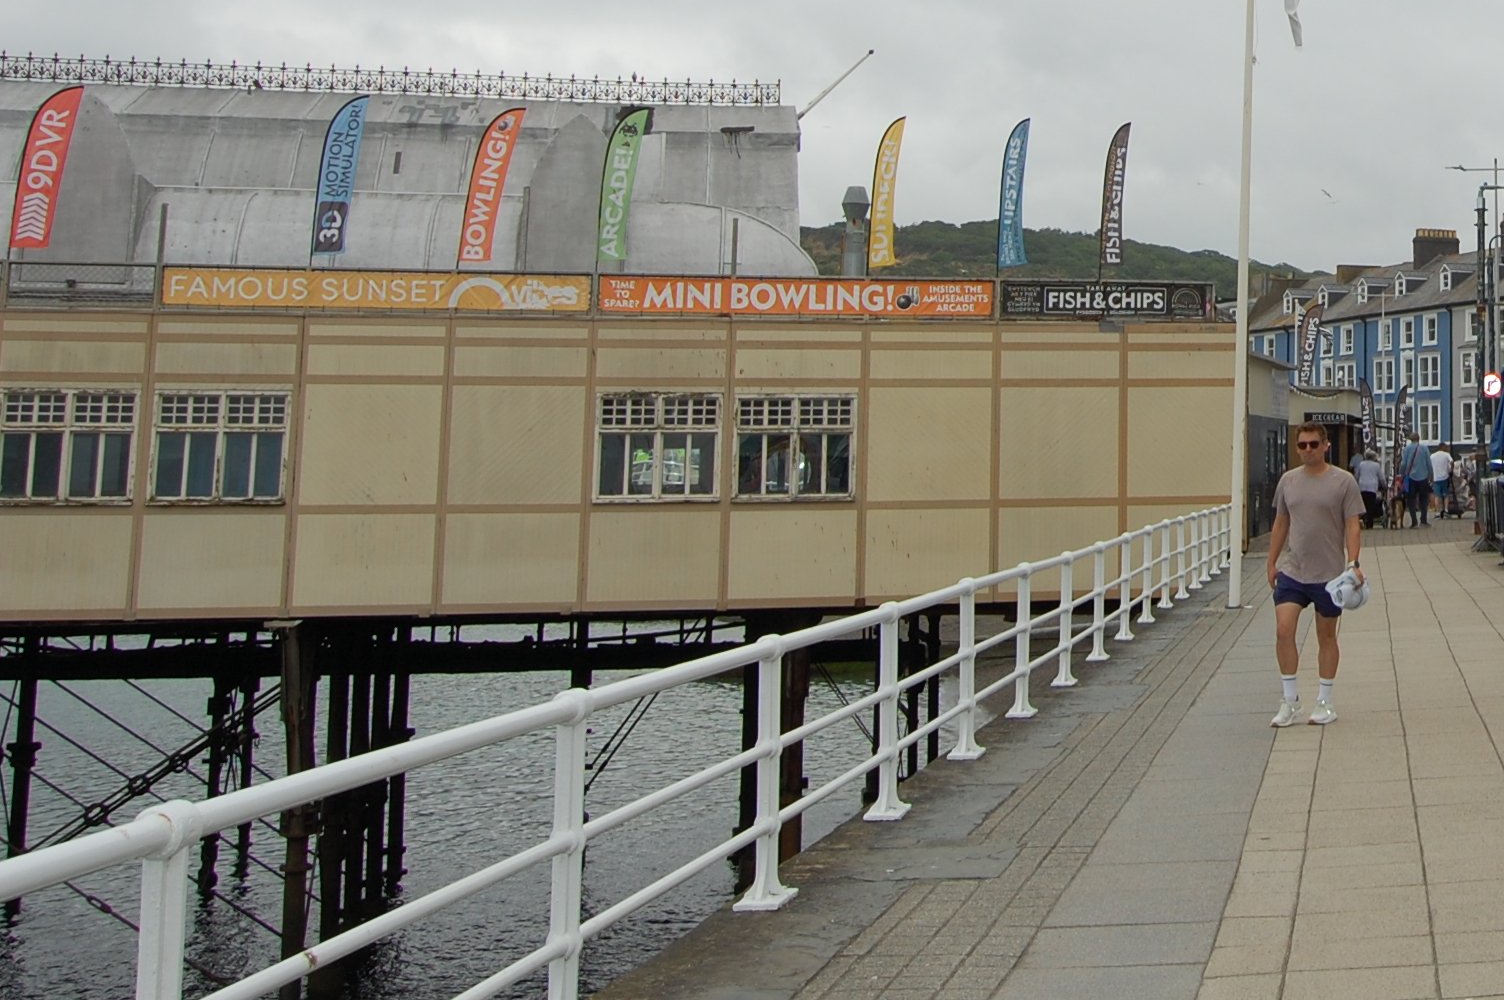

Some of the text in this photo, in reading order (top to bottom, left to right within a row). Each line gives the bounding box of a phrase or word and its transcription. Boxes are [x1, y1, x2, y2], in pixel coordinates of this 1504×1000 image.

[325, 131, 344, 197] MOTION
[336, 104, 363, 199] SIMULATOR!
[463, 131, 510, 259] BOWLING!
[1004, 137, 1021, 224] UPSTAIRS
[600, 147, 634, 258] ARCADE!
[319, 209, 342, 243] 3D
[170, 275, 307, 300] FAMOUS
[321, 278, 446, 302] SUNSET
[610, 280, 635, 289] TIME
[615, 290, 630, 298] TO
[643, 281, 894, 312] MINI BOWLING!
[922, 294, 989, 303] AMUSEMENTS
[929, 285, 983, 294] INSIDE THE
[604, 299, 640, 308] SPARE?
[936, 303, 975, 312] ARCADE
[1048, 292, 1090, 308] FISH
[1108, 292, 1164, 309] CHIPS
[1305, 317, 1319, 351] CHIPS
